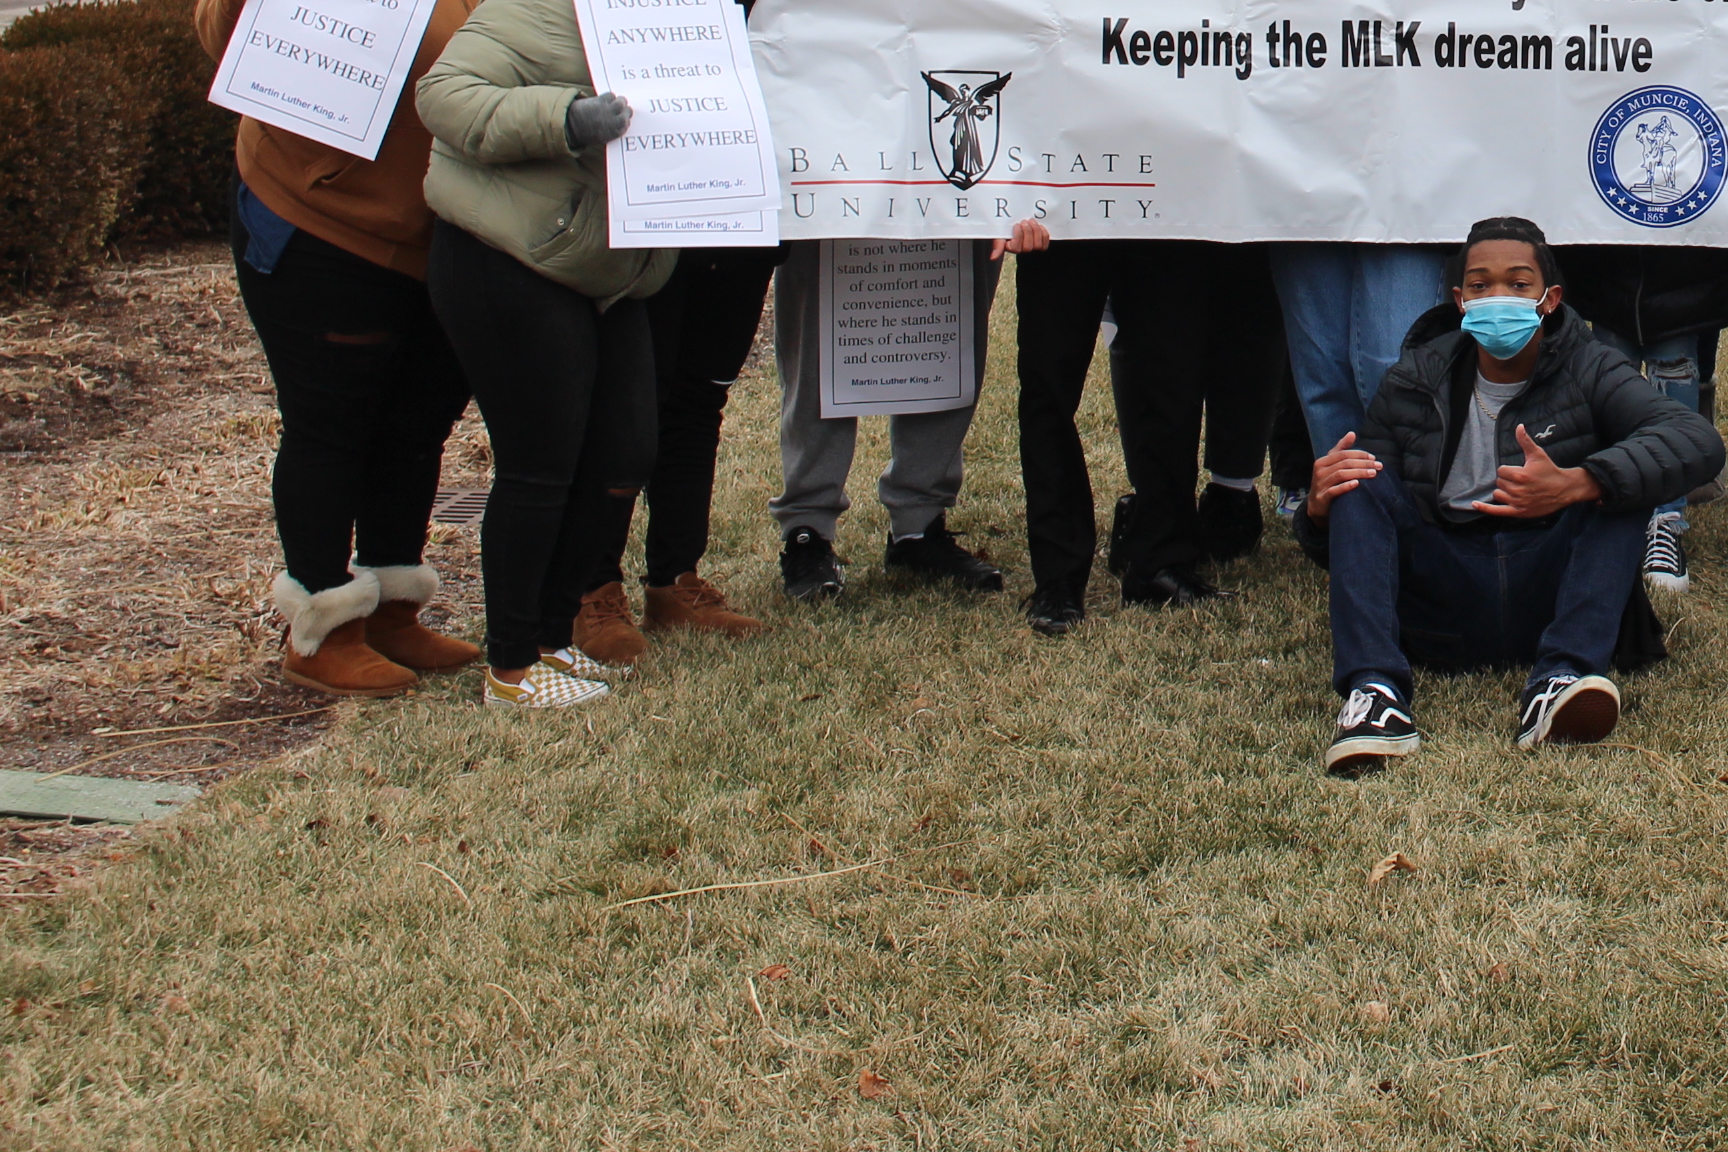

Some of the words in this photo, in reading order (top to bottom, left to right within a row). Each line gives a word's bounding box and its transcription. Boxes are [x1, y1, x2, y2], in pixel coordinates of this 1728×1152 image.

[291, 6, 376, 48] JUSTICE
[607, 26, 722, 45] ANYWHERE
[1103, 18, 1252, 80] Keeping
[1267, 21, 1327, 68] the
[1342, 21, 1420, 67] MLK
[1434, 26, 1552, 70] dream
[1566, 25, 1652, 72] alive
[250, 30, 385, 90] EVERYWHERE
[622, 65, 635, 79] is
[641, 68, 650, 78] a
[654, 64, 701, 78] threat
[705, 64, 721, 76] to
[251, 81, 279, 99] Martin
[281, 92, 311, 108] Luther
[313, 102, 336, 120] King,
[338, 112, 350, 123] Jr.
[650, 98, 727, 113] JUSTICE
[1596, 130, 1611, 165] CITY
[1608, 107, 1626, 129] OF
[1628, 94, 1689, 114] MUNCIE,
[1693, 109, 1722, 168] INDIANA
[625, 130, 756, 152] EVERYWHERE
[790, 148, 924, 173] BALL
[1007, 148, 1154, 173] STATE
[793, 194, 1154, 220] UNIVERSITY
[1643, 212, 1664, 222] 1865
[849, 244, 859, 256] is
[864, 245, 884, 255] not
[889, 242, 927, 253] where
[931, 240, 945, 251] he
[838, 262, 878, 274] stands
[883, 261, 895, 272] in
[900, 258, 957, 271] moments
[850, 280, 864, 292] of
[868, 279, 918, 291] comfort
[923, 276, 945, 288] and
[843, 298, 927, 310] convenience,
[932, 294, 952, 306] but
[838, 317, 877, 328] where
[882, 316, 897, 327] he
[902, 312, 940, 326] stands
[945, 311, 956, 323] in
[839, 335, 873, 346] times
[878, 334, 892, 345] of
[896, 331, 956, 344] challenge
[844, 353, 867, 364] and
[872, 350, 951, 363] controversy.
[852, 378, 878, 386] Martin
[881, 377, 907, 385] Luther
[910, 376, 931, 384] King,
